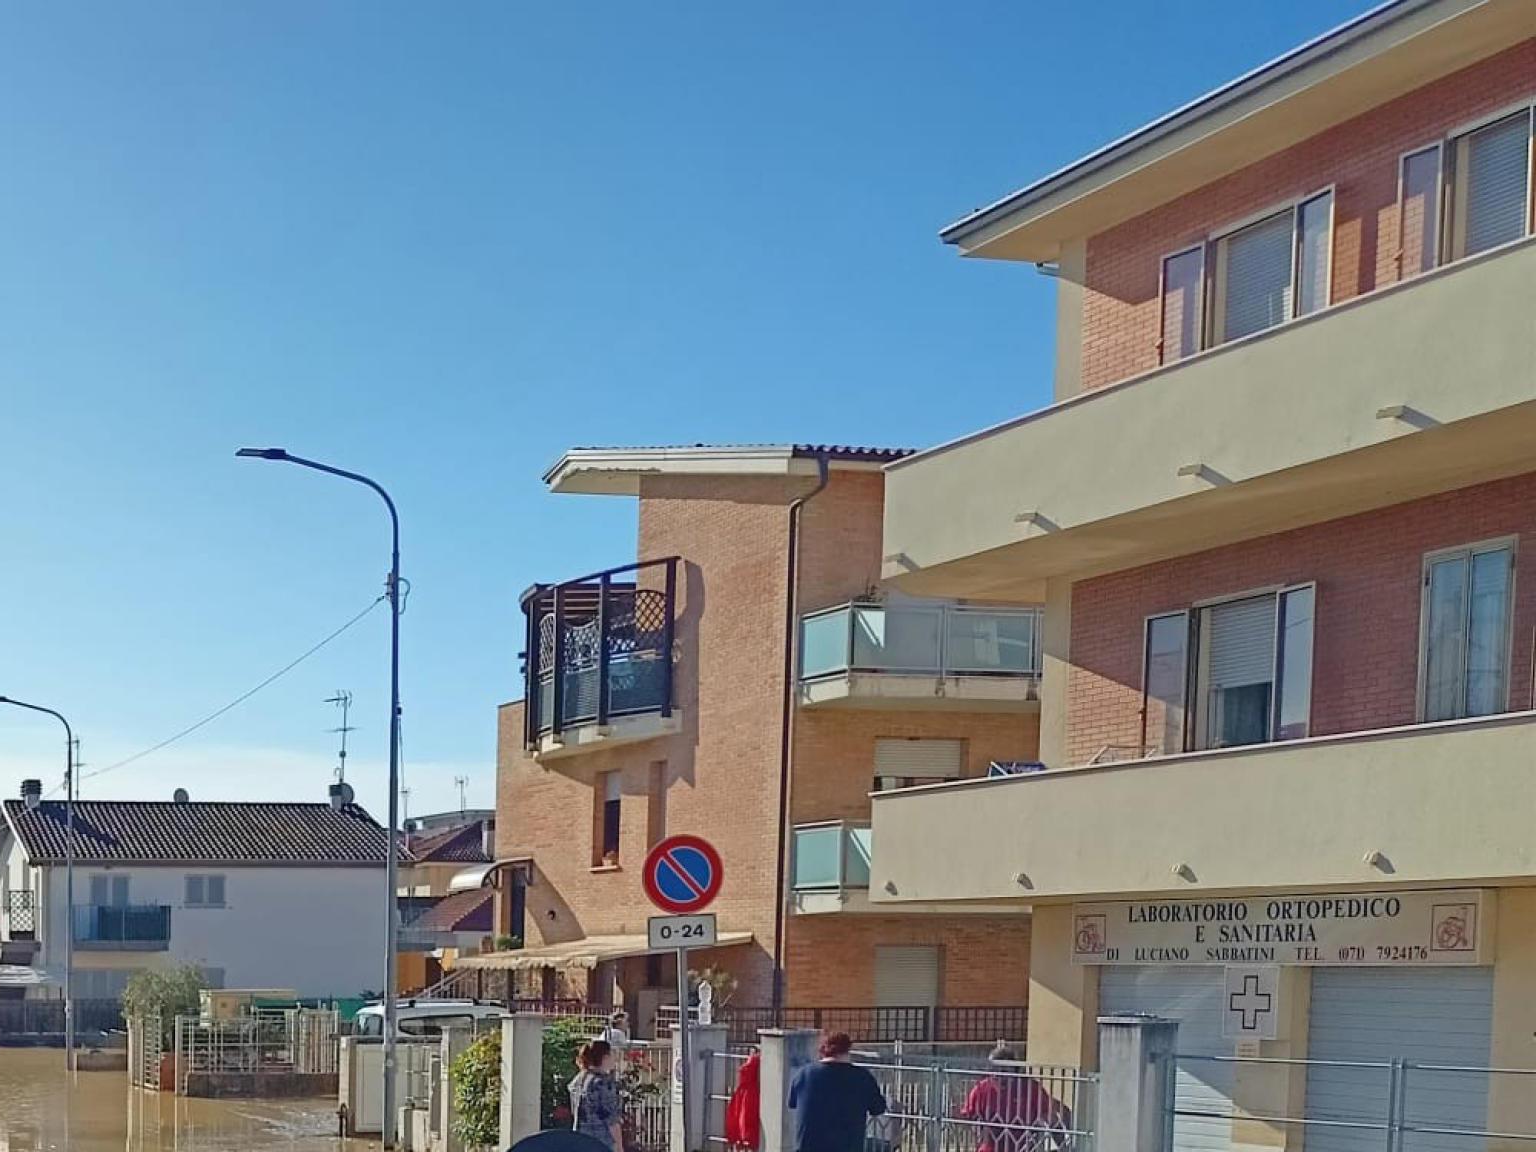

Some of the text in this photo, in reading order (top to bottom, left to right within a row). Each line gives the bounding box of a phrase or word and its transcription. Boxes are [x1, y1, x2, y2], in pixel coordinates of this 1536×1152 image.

[1128, 898, 1401, 923] LABORATORIO ORTOPEDICO
[660, 924, 704, 939] 0-24
[1195, 924, 1316, 943] E SANITARIA
[1106, 948, 1119, 961] DI
[1134, 948, 1190, 961] LUCIANO
[1206, 947, 1275, 961] SABBATINI
[1376, 946, 1428, 961] 7924176
